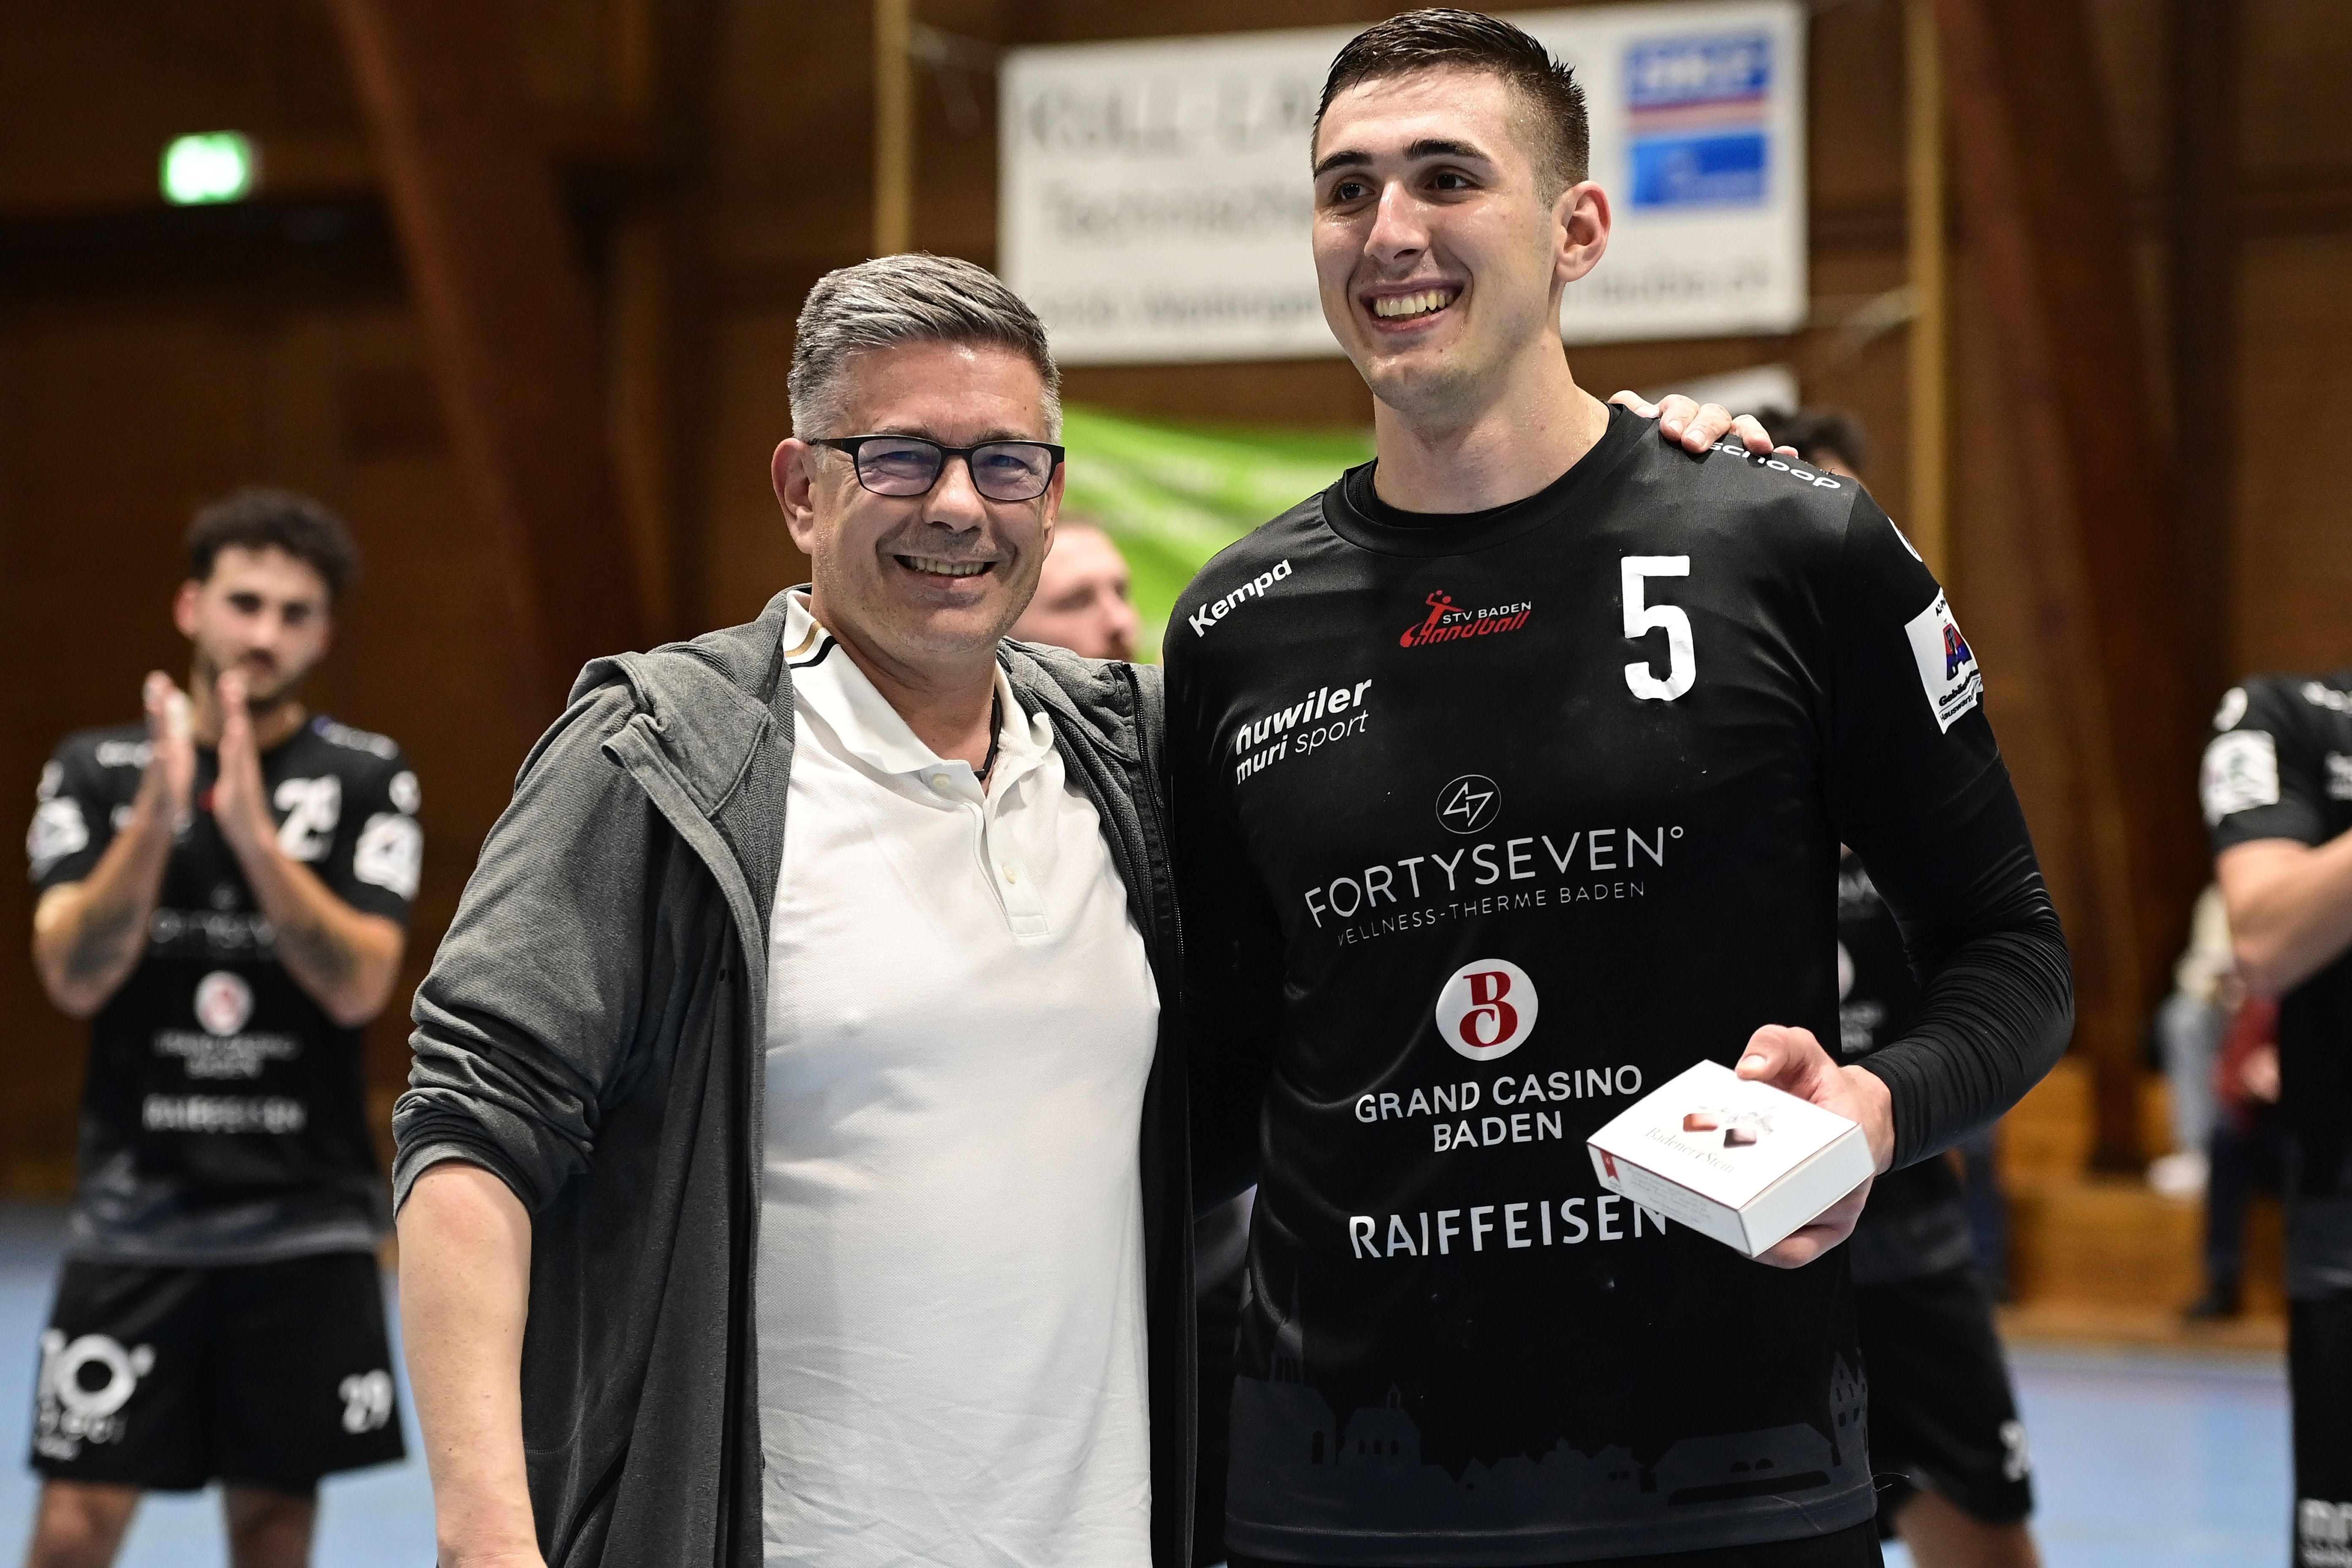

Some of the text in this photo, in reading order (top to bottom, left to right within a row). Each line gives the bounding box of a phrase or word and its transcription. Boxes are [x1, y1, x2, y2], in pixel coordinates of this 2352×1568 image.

[1188, 559, 1293, 638] Kempa
[1443, 601, 1532, 624] STV BADEN
[1621, 555, 1696, 702] 5
[1236, 679, 1372, 755] huwiler
[1236, 710, 1369, 785] muri sport
[1560, 881, 1645, 904] BADEN
[1355, 1065, 1643, 1123] GRAND CASINO
[1433, 1111, 1563, 1152] BADEN
[1349, 1195, 1666, 1259] RAIFFEISEN
